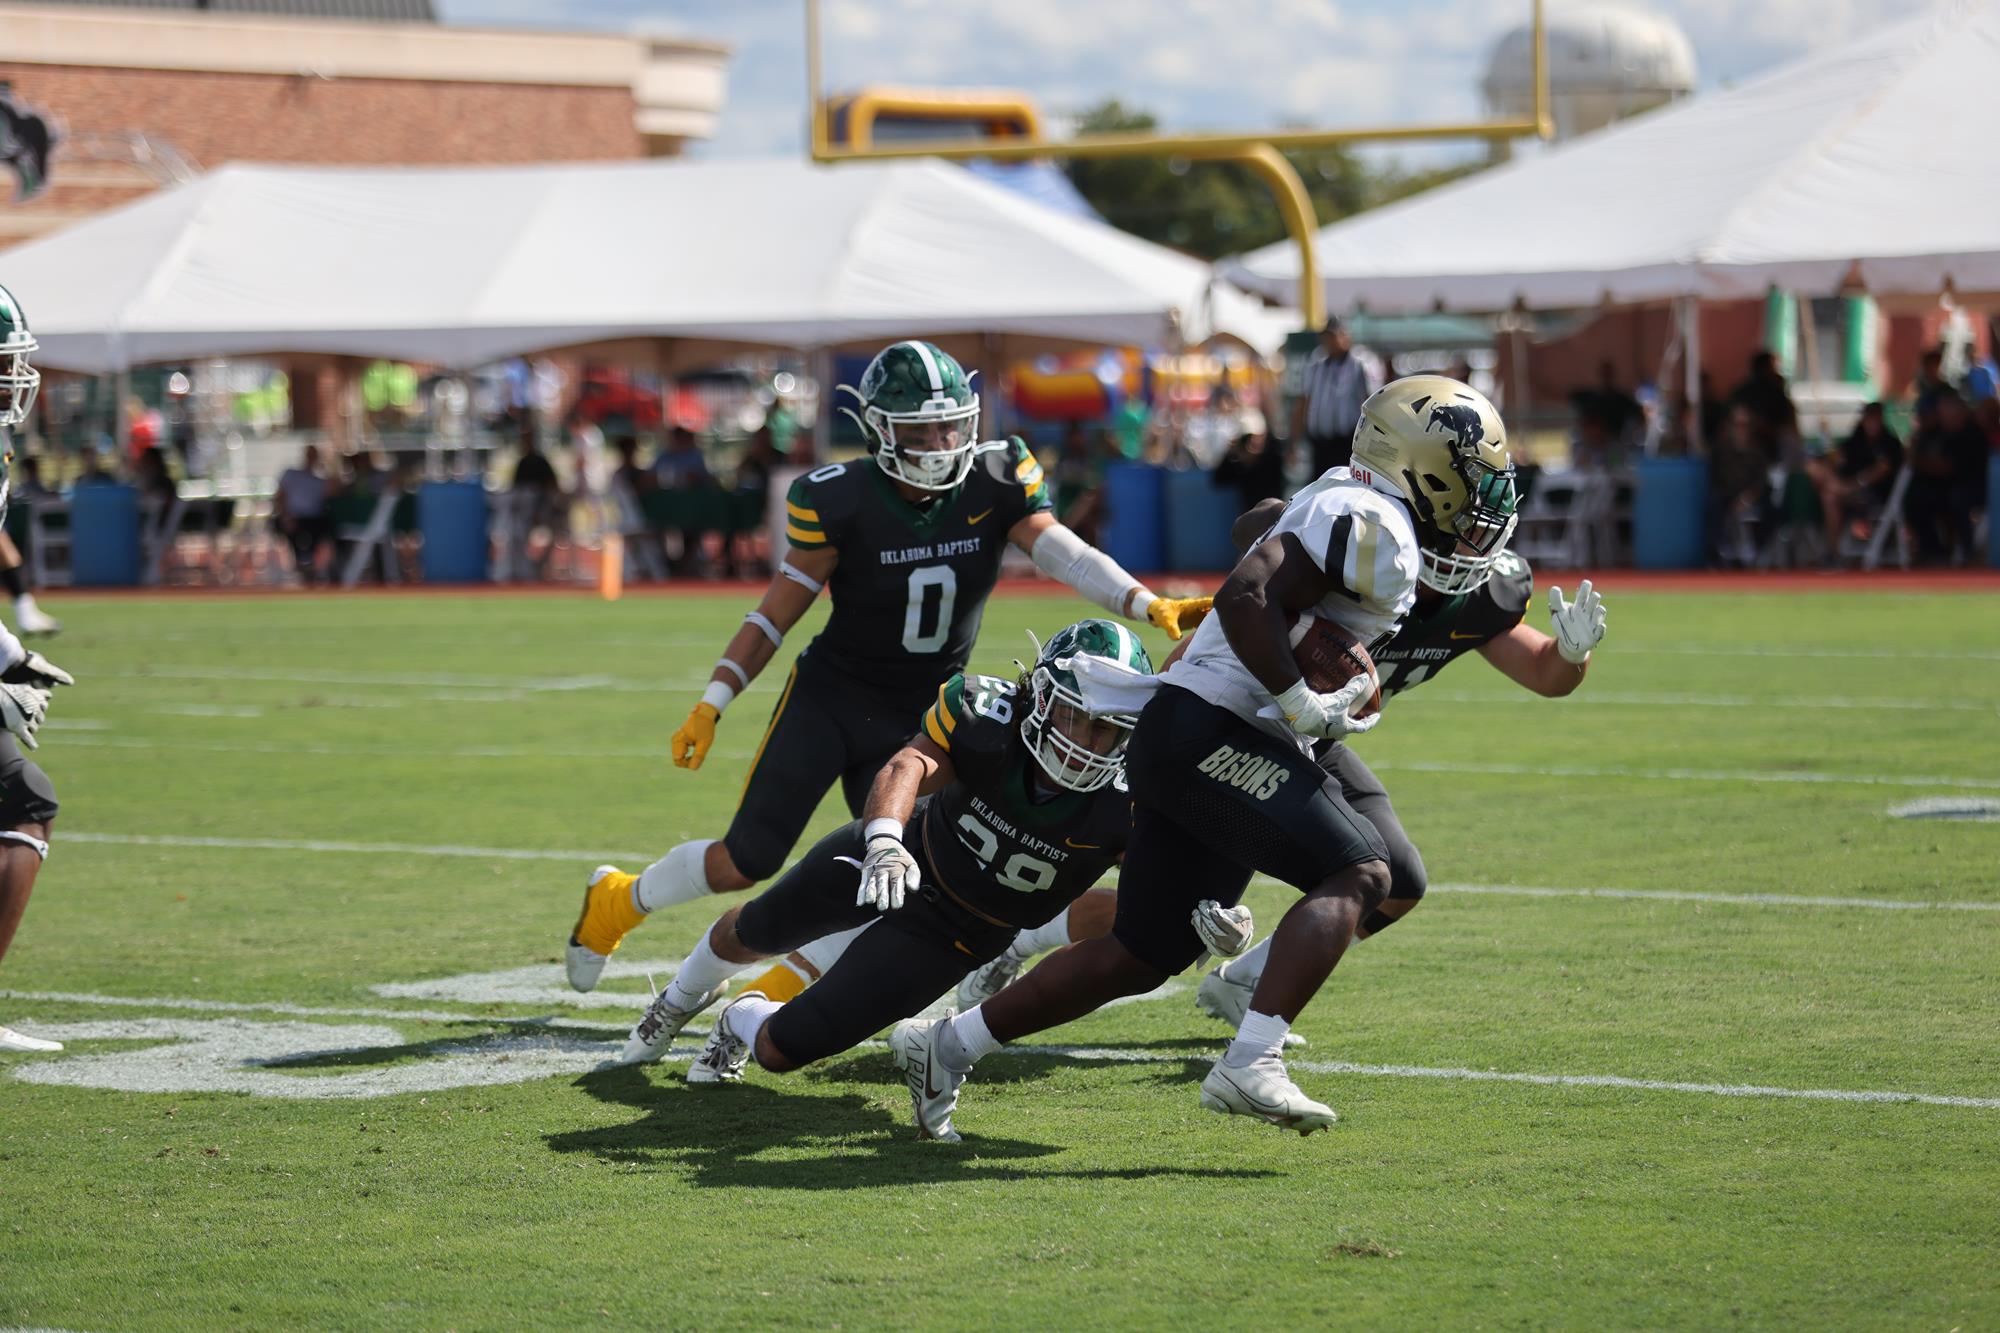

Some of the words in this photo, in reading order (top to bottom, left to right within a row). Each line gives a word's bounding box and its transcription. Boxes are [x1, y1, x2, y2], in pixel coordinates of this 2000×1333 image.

[808, 463, 847, 483] 0
[880, 546, 933, 565] OKLAHOMA
[937, 537, 980, 557] BAPTIST
[902, 565, 957, 653] 0
[1410, 647, 1452, 661] BAPTIST
[1197, 744, 1290, 801] BISONS
[957, 814, 1058, 893] 29
[970, 796, 1018, 839] OKLAHOMA
[1020, 833, 1069, 862] BAPTIST
